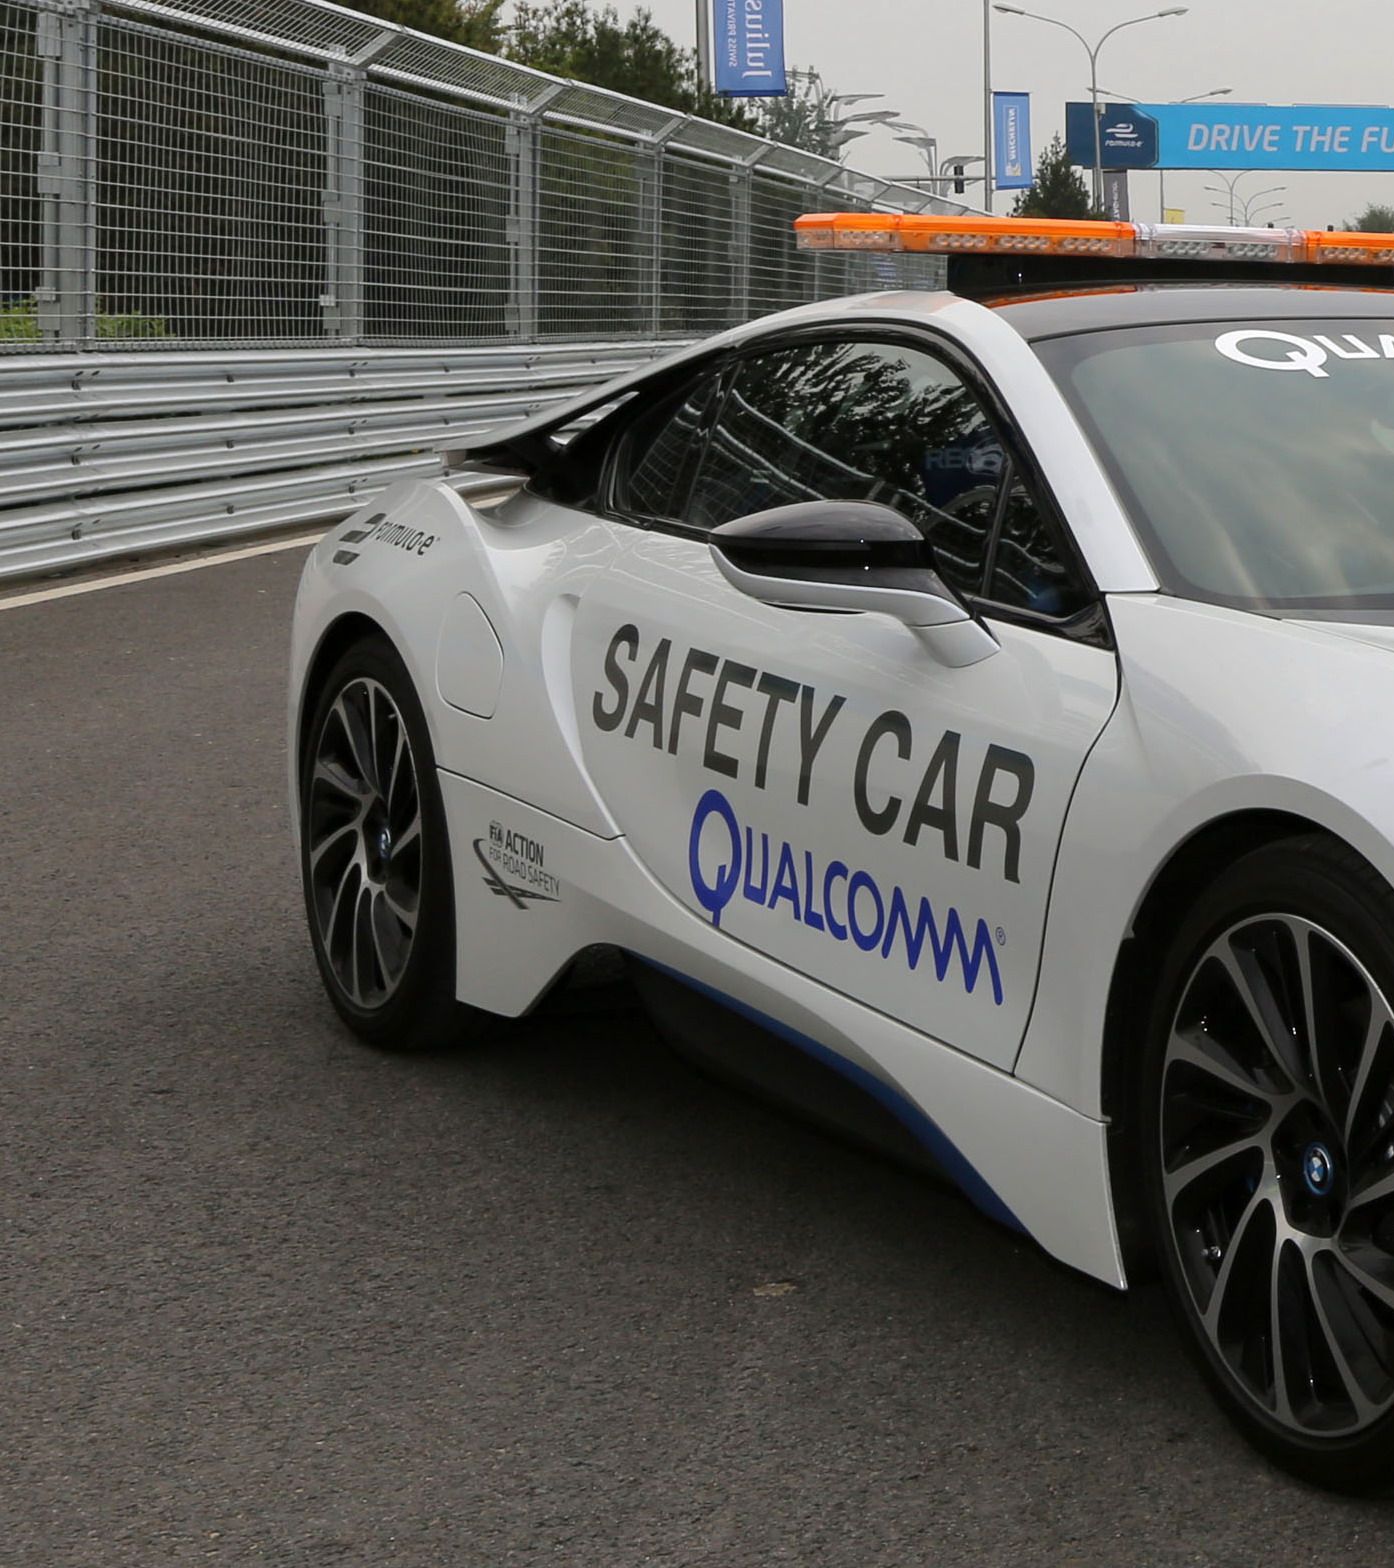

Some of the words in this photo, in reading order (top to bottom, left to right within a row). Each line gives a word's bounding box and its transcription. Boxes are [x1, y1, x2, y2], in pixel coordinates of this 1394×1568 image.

[1187, 123, 1281, 151] DRIVE
[1292, 125, 1353, 153] THE
[592, 623, 848, 807] SAFETY
[854, 710, 1036, 884] CAR
[489, 846, 501, 861] FOR
[503, 853, 527, 880] ROAD
[528, 865, 560, 897] SAFETY
[505, 830, 544, 867] ACTION
[689, 789, 1003, 1005] QUALCOMM
